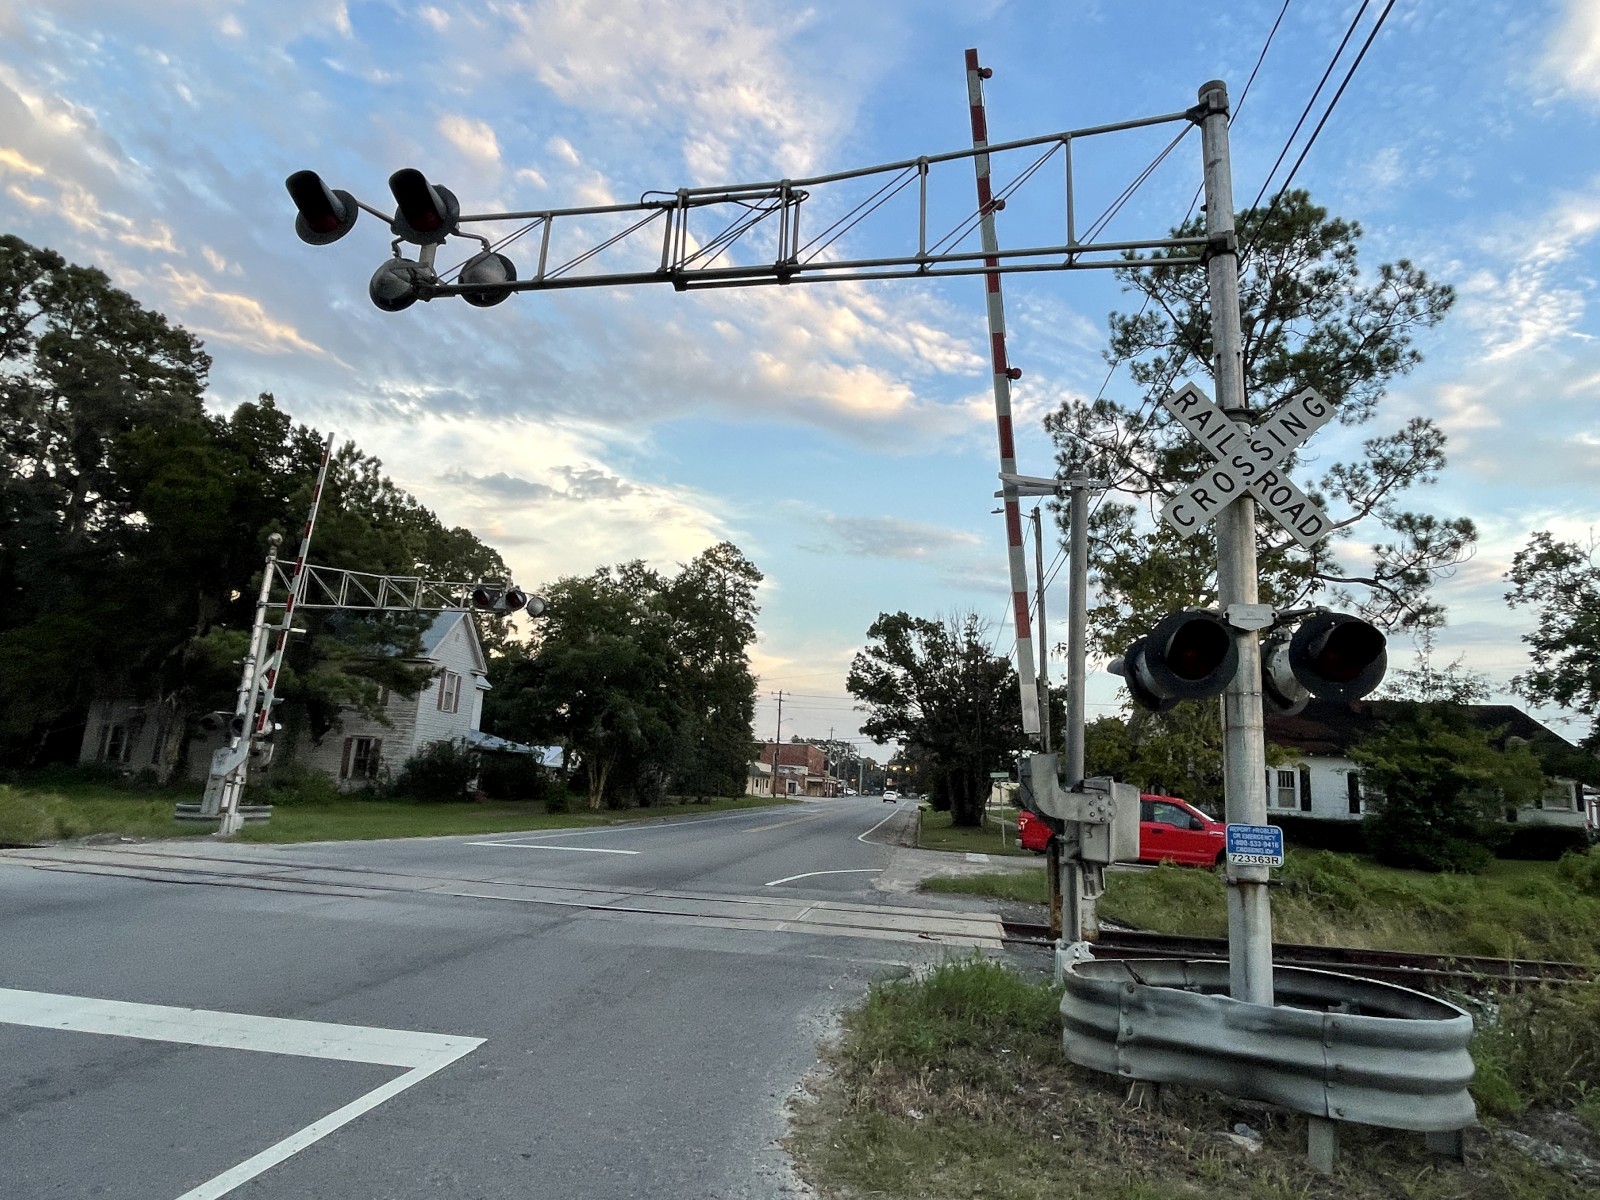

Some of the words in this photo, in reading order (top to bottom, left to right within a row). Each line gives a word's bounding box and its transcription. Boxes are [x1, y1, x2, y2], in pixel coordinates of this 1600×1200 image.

[1172, 396, 1326, 527] CROSSING
[1173, 390, 1235, 456] RAIL
[1253, 470, 1323, 537] ROAD
[1232, 855, 1279, 864] 723363R
